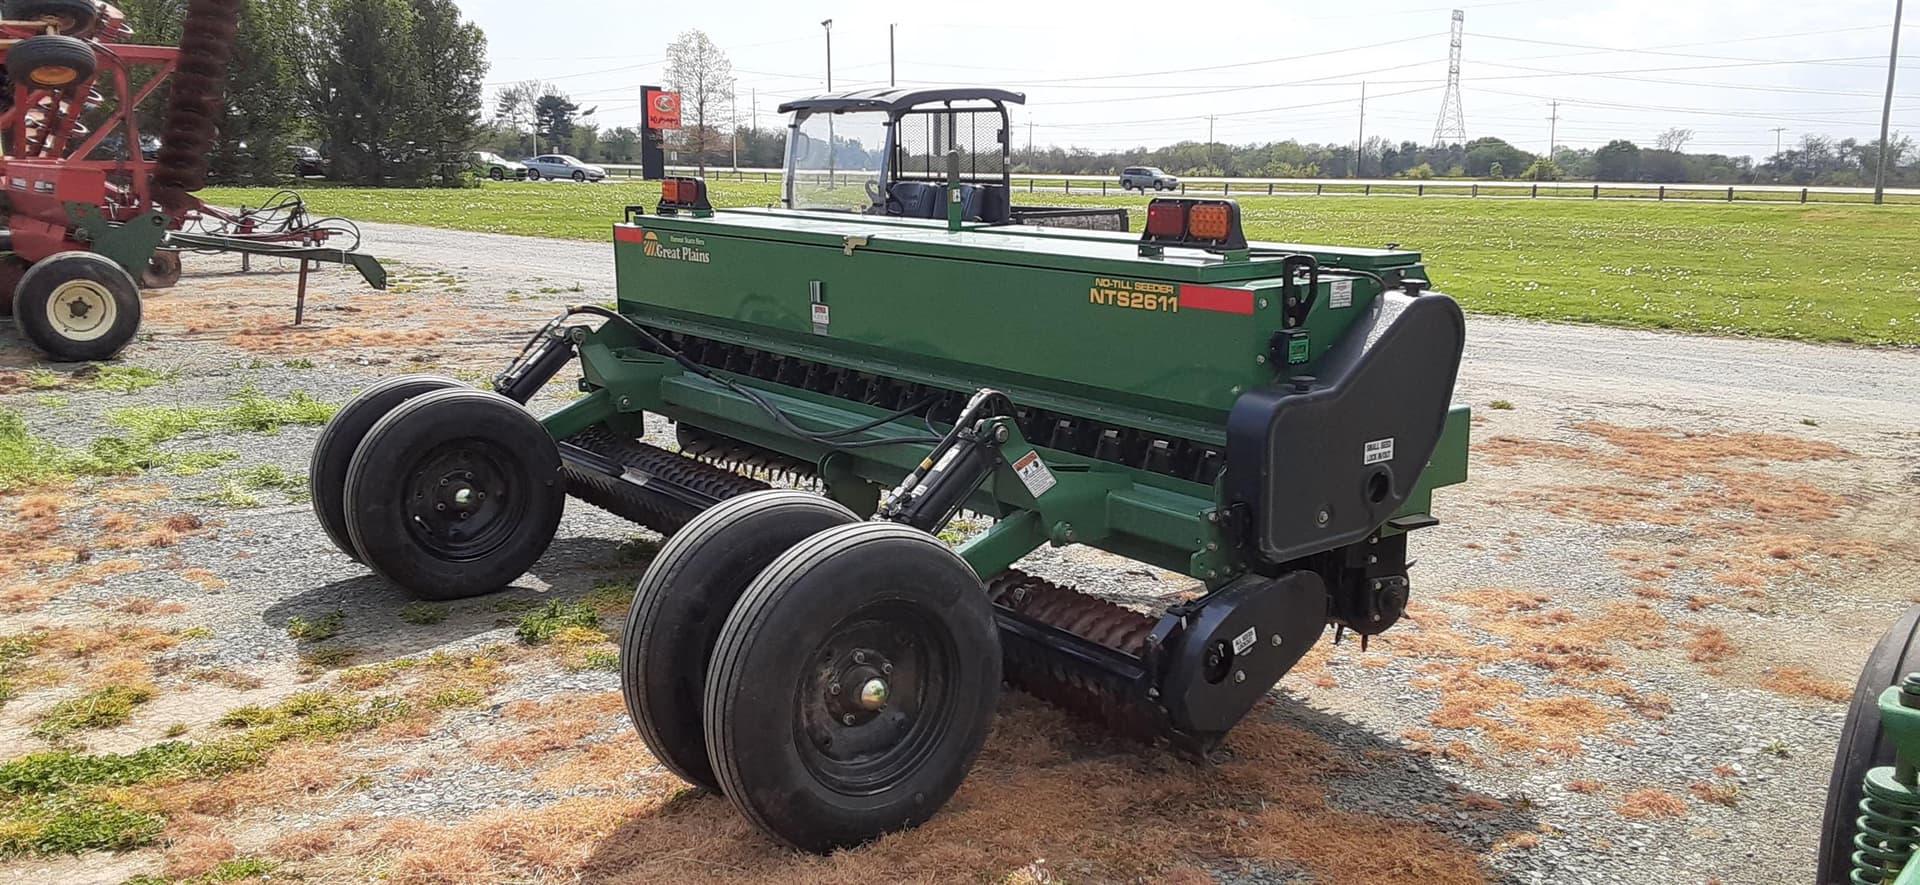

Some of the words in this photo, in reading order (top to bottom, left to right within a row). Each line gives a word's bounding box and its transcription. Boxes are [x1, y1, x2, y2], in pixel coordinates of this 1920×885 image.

[656, 244, 681, 260] Great
[682, 247, 710, 263] Plains
[1095, 278, 1132, 290] NO-TILL
[1134, 282, 1174, 294] SEEDER
[1090, 288, 1178, 313] NTS2611
